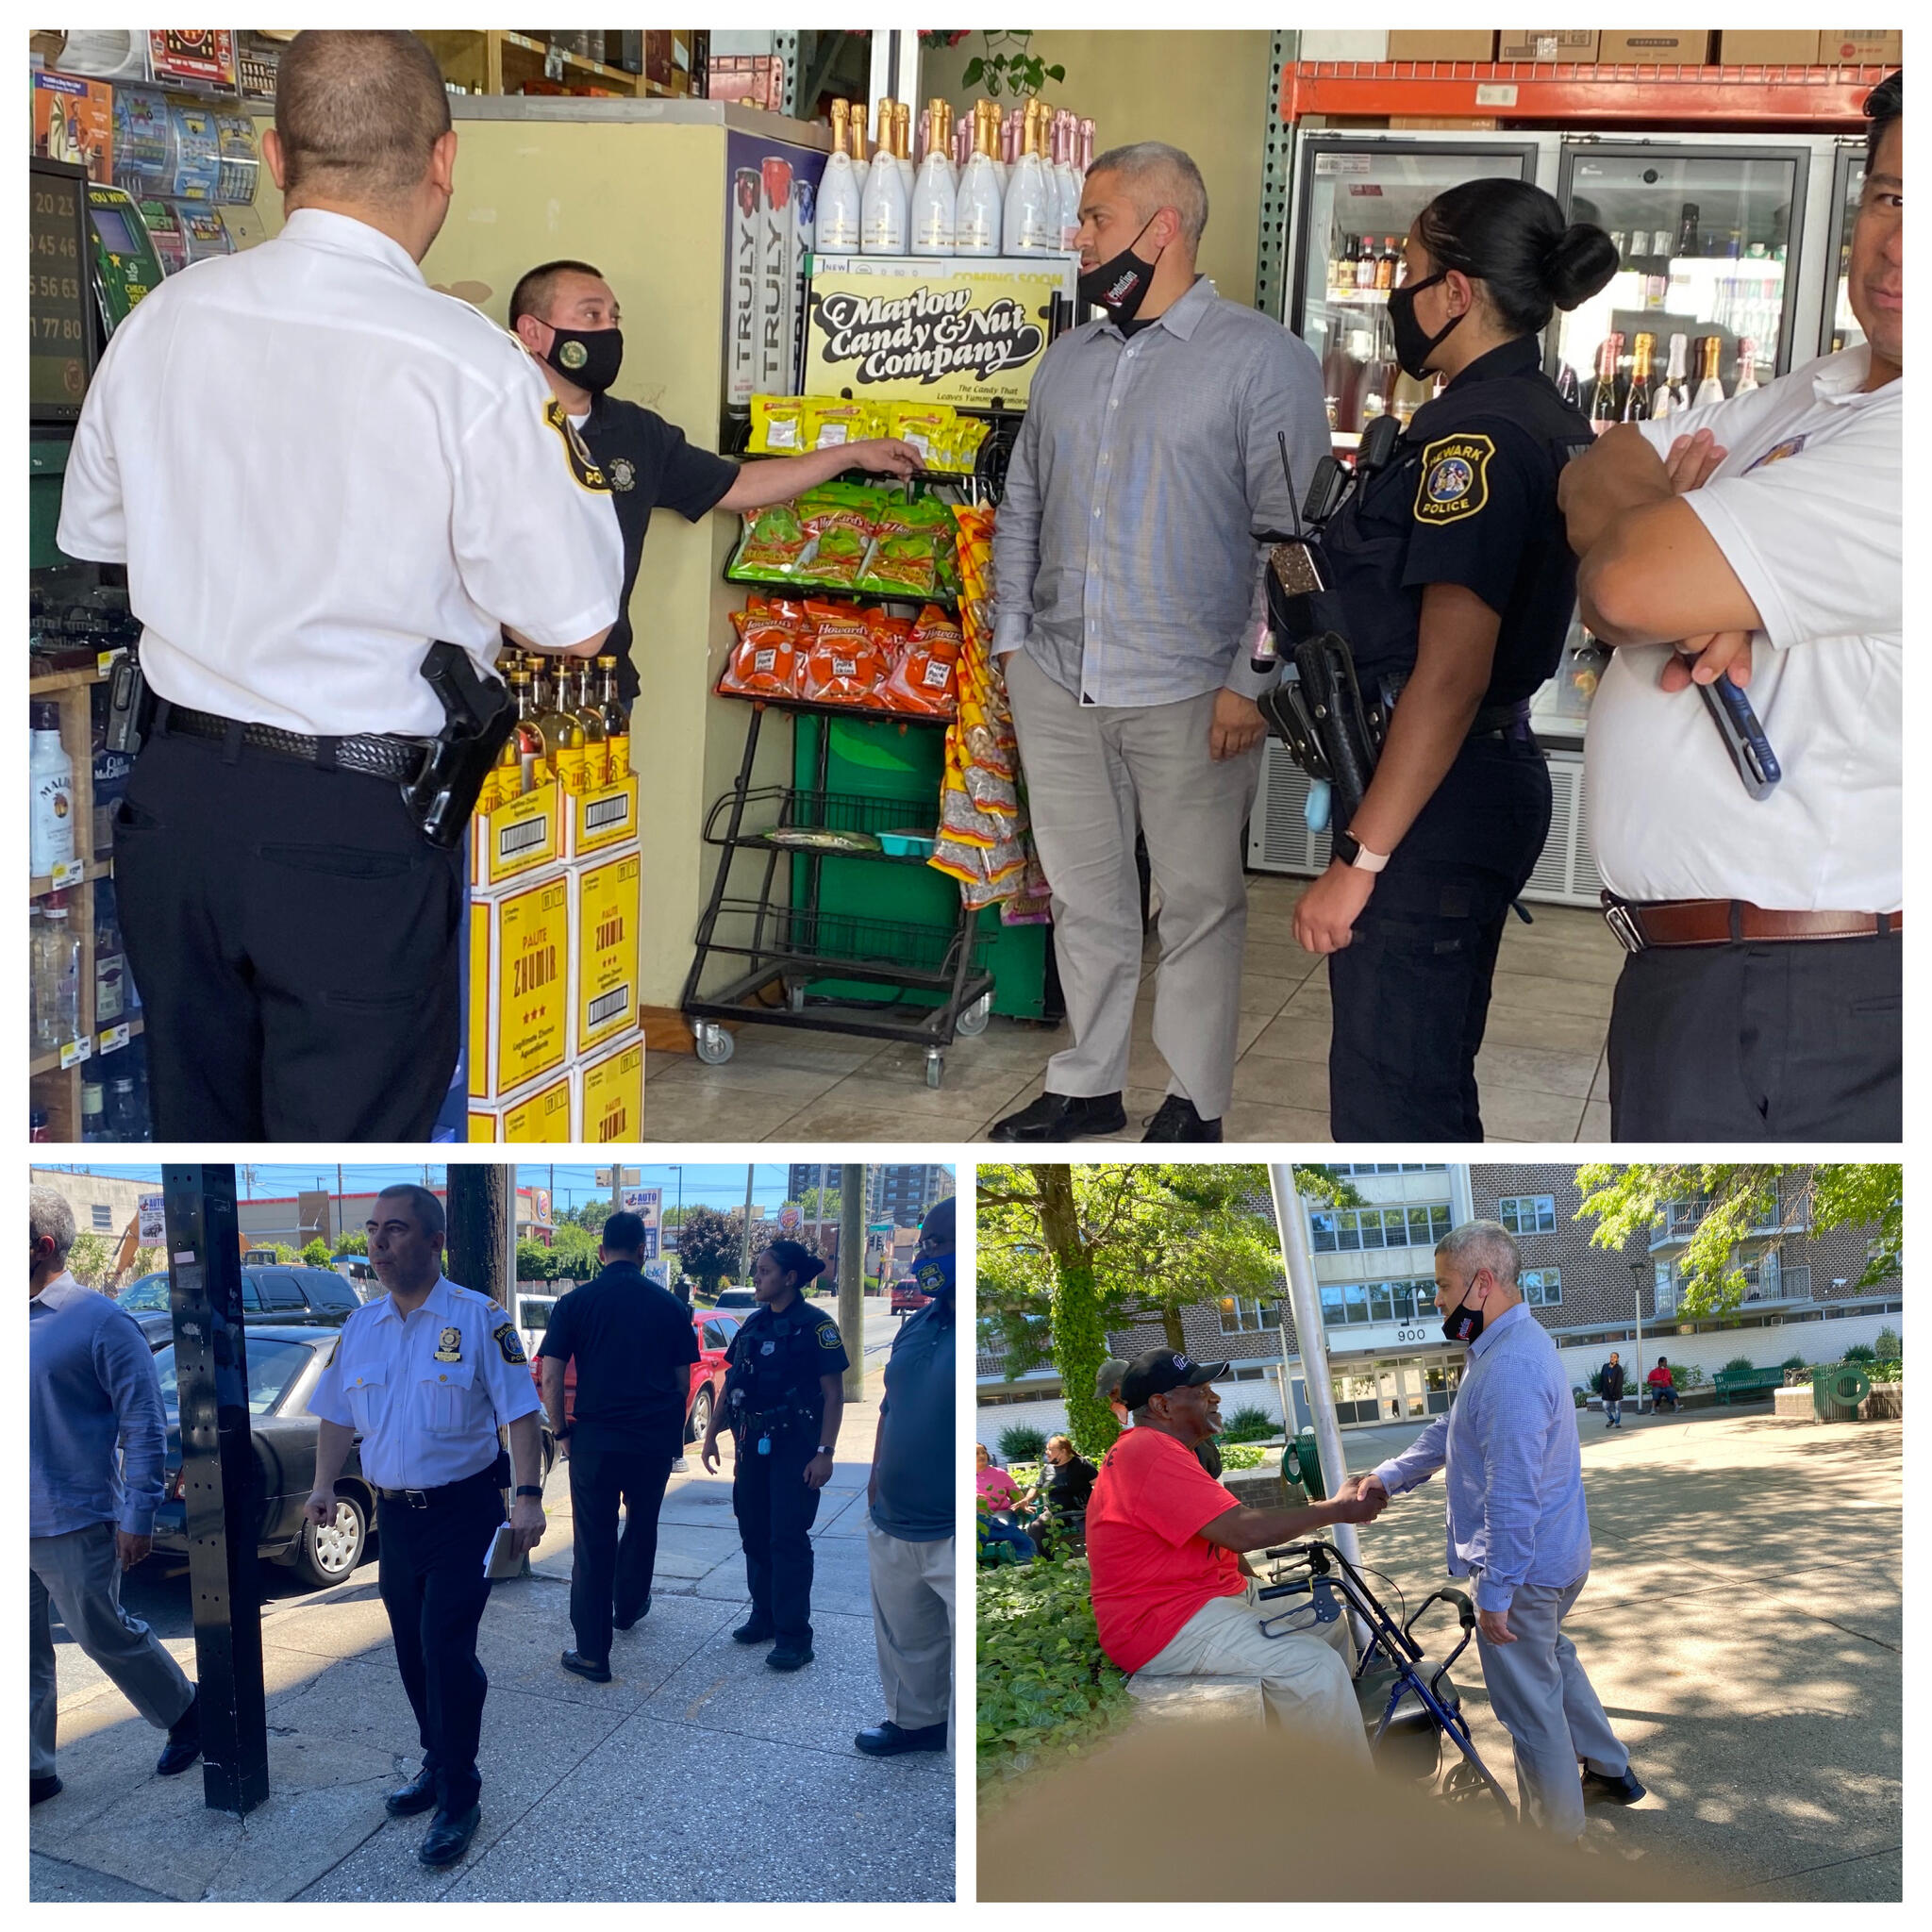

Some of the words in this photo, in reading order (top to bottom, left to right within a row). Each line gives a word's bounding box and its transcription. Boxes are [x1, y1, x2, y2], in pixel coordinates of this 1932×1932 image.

[37, 192, 54, 214] 20
[58, 196, 75, 216] 23
[88, 192, 108, 204] YOU
[39, 236, 56, 256] 45
[60, 238, 77, 258] 46
[825, 263, 846, 272] NEW
[41, 277, 58, 297] 56
[61, 278, 79, 299] 63
[125, 284, 148, 294] CHECK
[1017, 273, 1064, 285] SOON
[128, 292, 148, 304] YOU
[736, 222, 755, 371] TRULY
[763, 217, 782, 382] TRULY
[823, 285, 972, 330] Marlow
[42, 318, 59, 339] 77
[63, 319, 82, 341] 80
[830, 317, 930, 358] Candy
[933, 314, 966, 344] &
[957, 297, 1025, 342] Nut
[864, 324, 1043, 377] Company
[937, 392, 963, 402] Leaves
[958, 384, 972, 393] The
[974, 385, 998, 396] Candy
[1000, 386, 1019, 395] That
[1429, 445, 1483, 466] NEWARK
[1422, 499, 1469, 513] POLICE
[818, 623, 870, 636] Howard's
[595, 916, 624, 953] ZHUMIR
[513, 944, 557, 999] ZHUMIR
[638, 1191, 657, 1202] AUTO
[1397, 1328, 1425, 1341] 900
